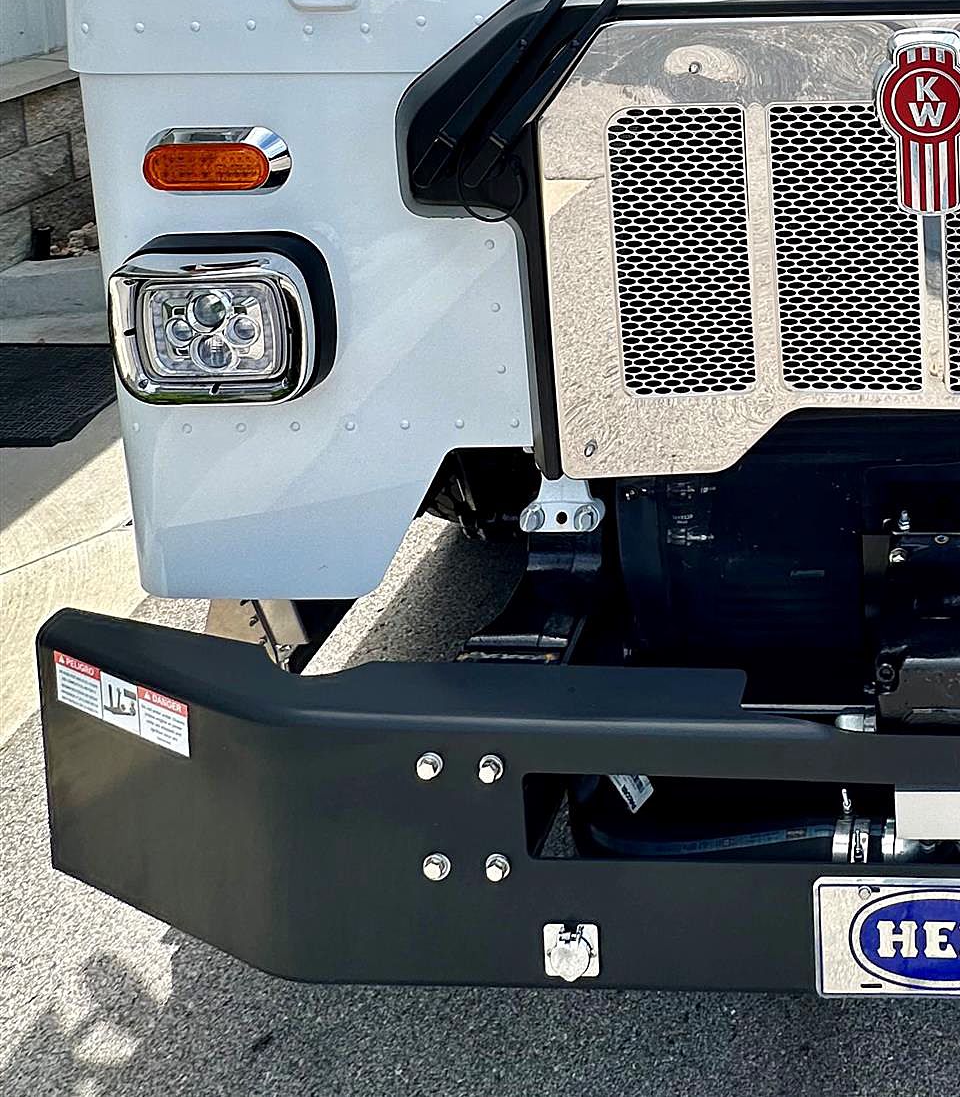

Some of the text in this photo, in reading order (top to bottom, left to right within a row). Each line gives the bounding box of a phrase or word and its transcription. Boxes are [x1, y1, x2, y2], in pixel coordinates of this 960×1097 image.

[915, 76, 941, 102] K
[908, 102, 947, 127] W
[65, 657, 95, 676] PELIGRO
[151, 694, 182, 712] DANGER
